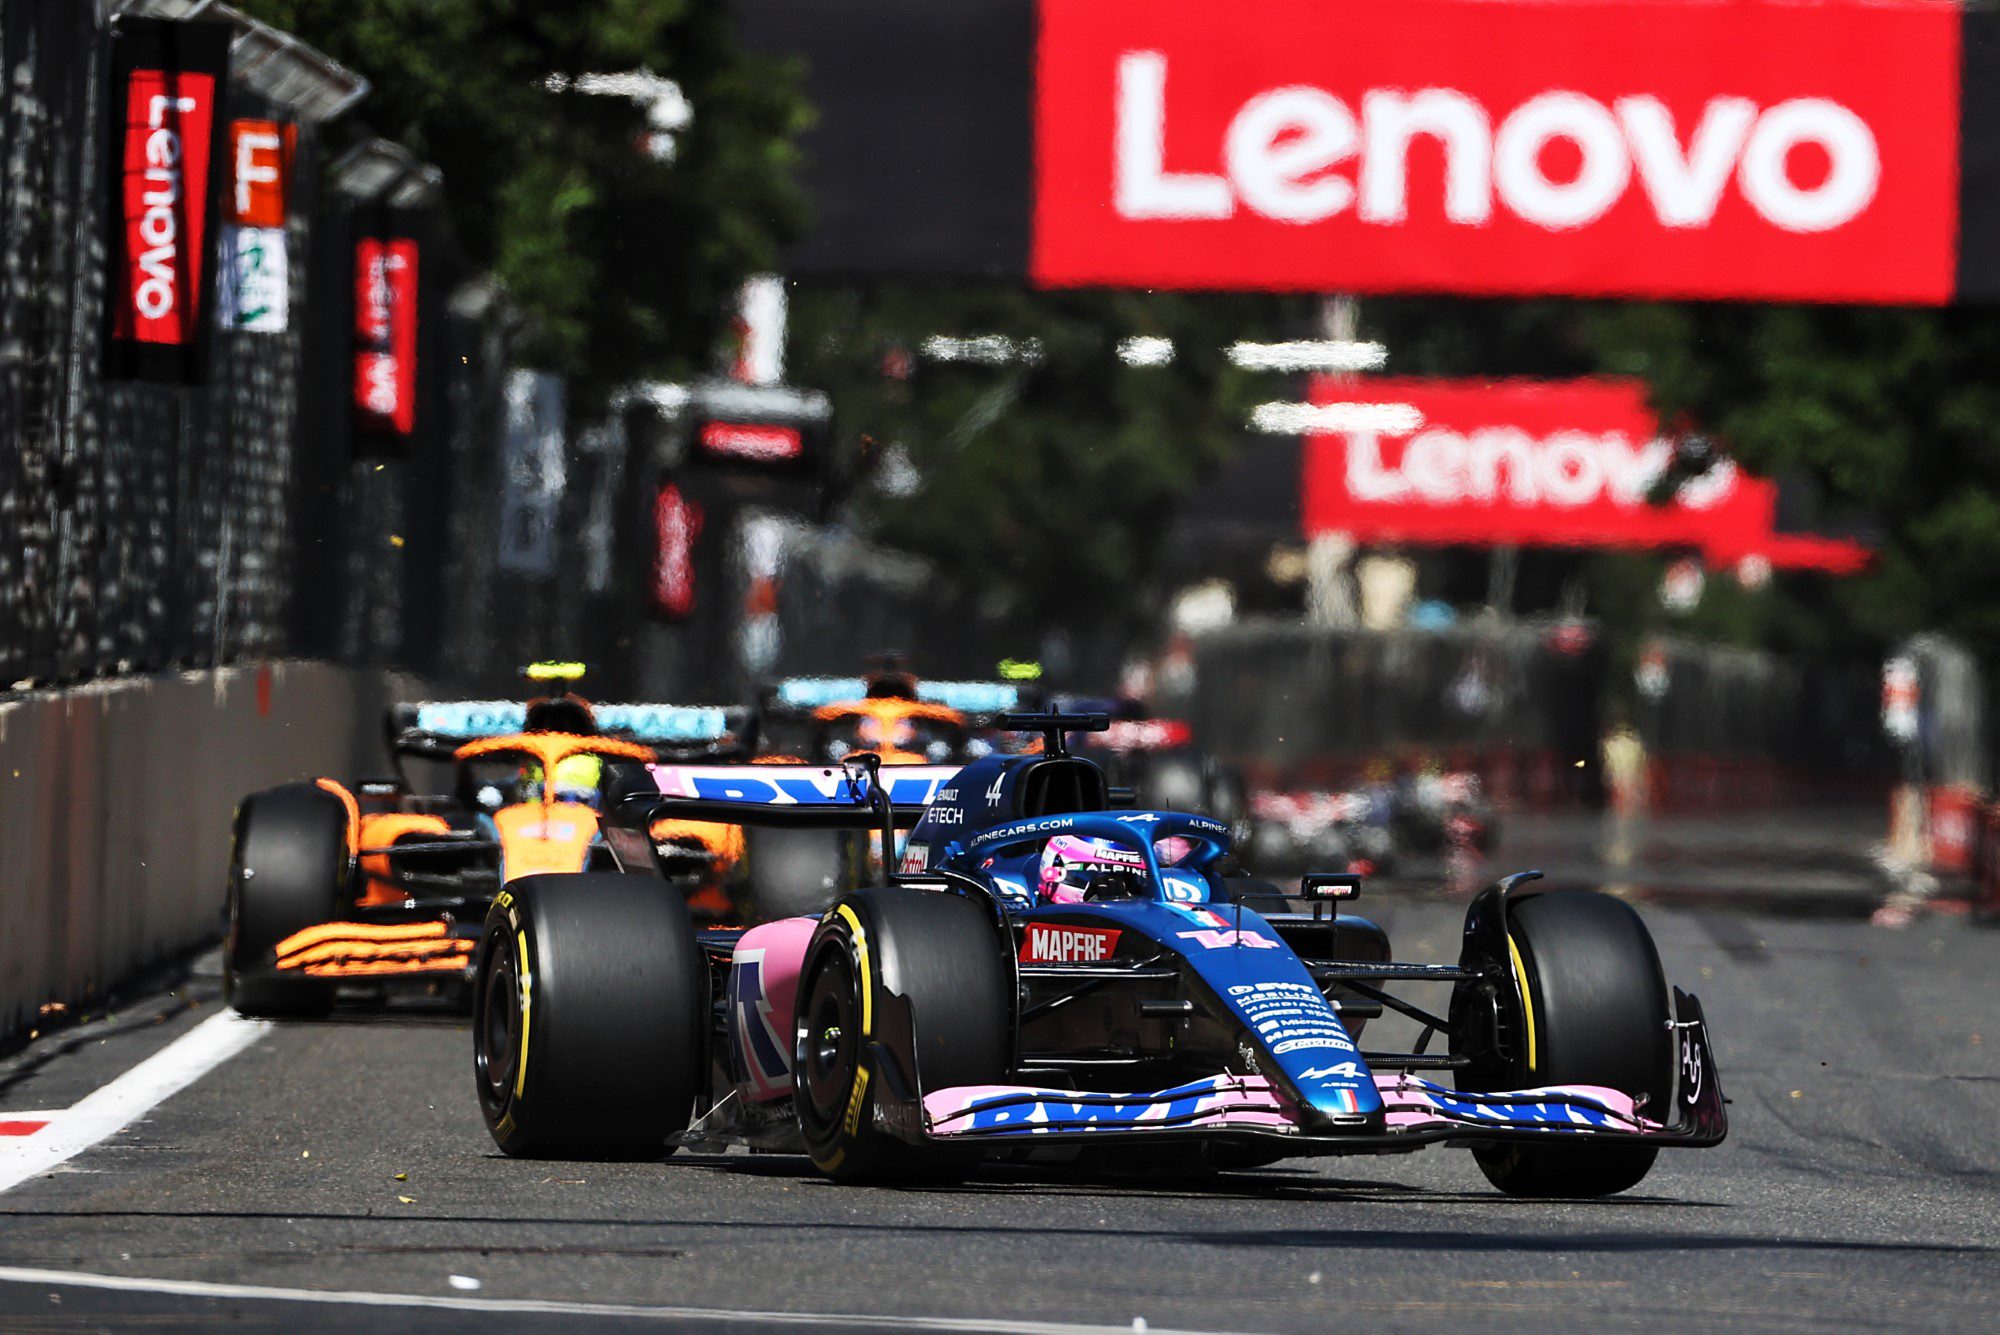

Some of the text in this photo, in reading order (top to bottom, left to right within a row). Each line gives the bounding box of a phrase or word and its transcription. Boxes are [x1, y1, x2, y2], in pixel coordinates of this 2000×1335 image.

[1114, 50, 1882, 233] Lenovo
[136, 95, 196, 320] Lenovo
[367, 254, 408, 414] Lenvo
[936, 789, 959, 801] ENAULT
[928, 807, 963, 824] E-TECH
[970, 818, 1074, 847] ALPINECARS.COM
[1086, 863, 1148, 878] ALPINE
[1032, 928, 1107, 961] MAPFRE
